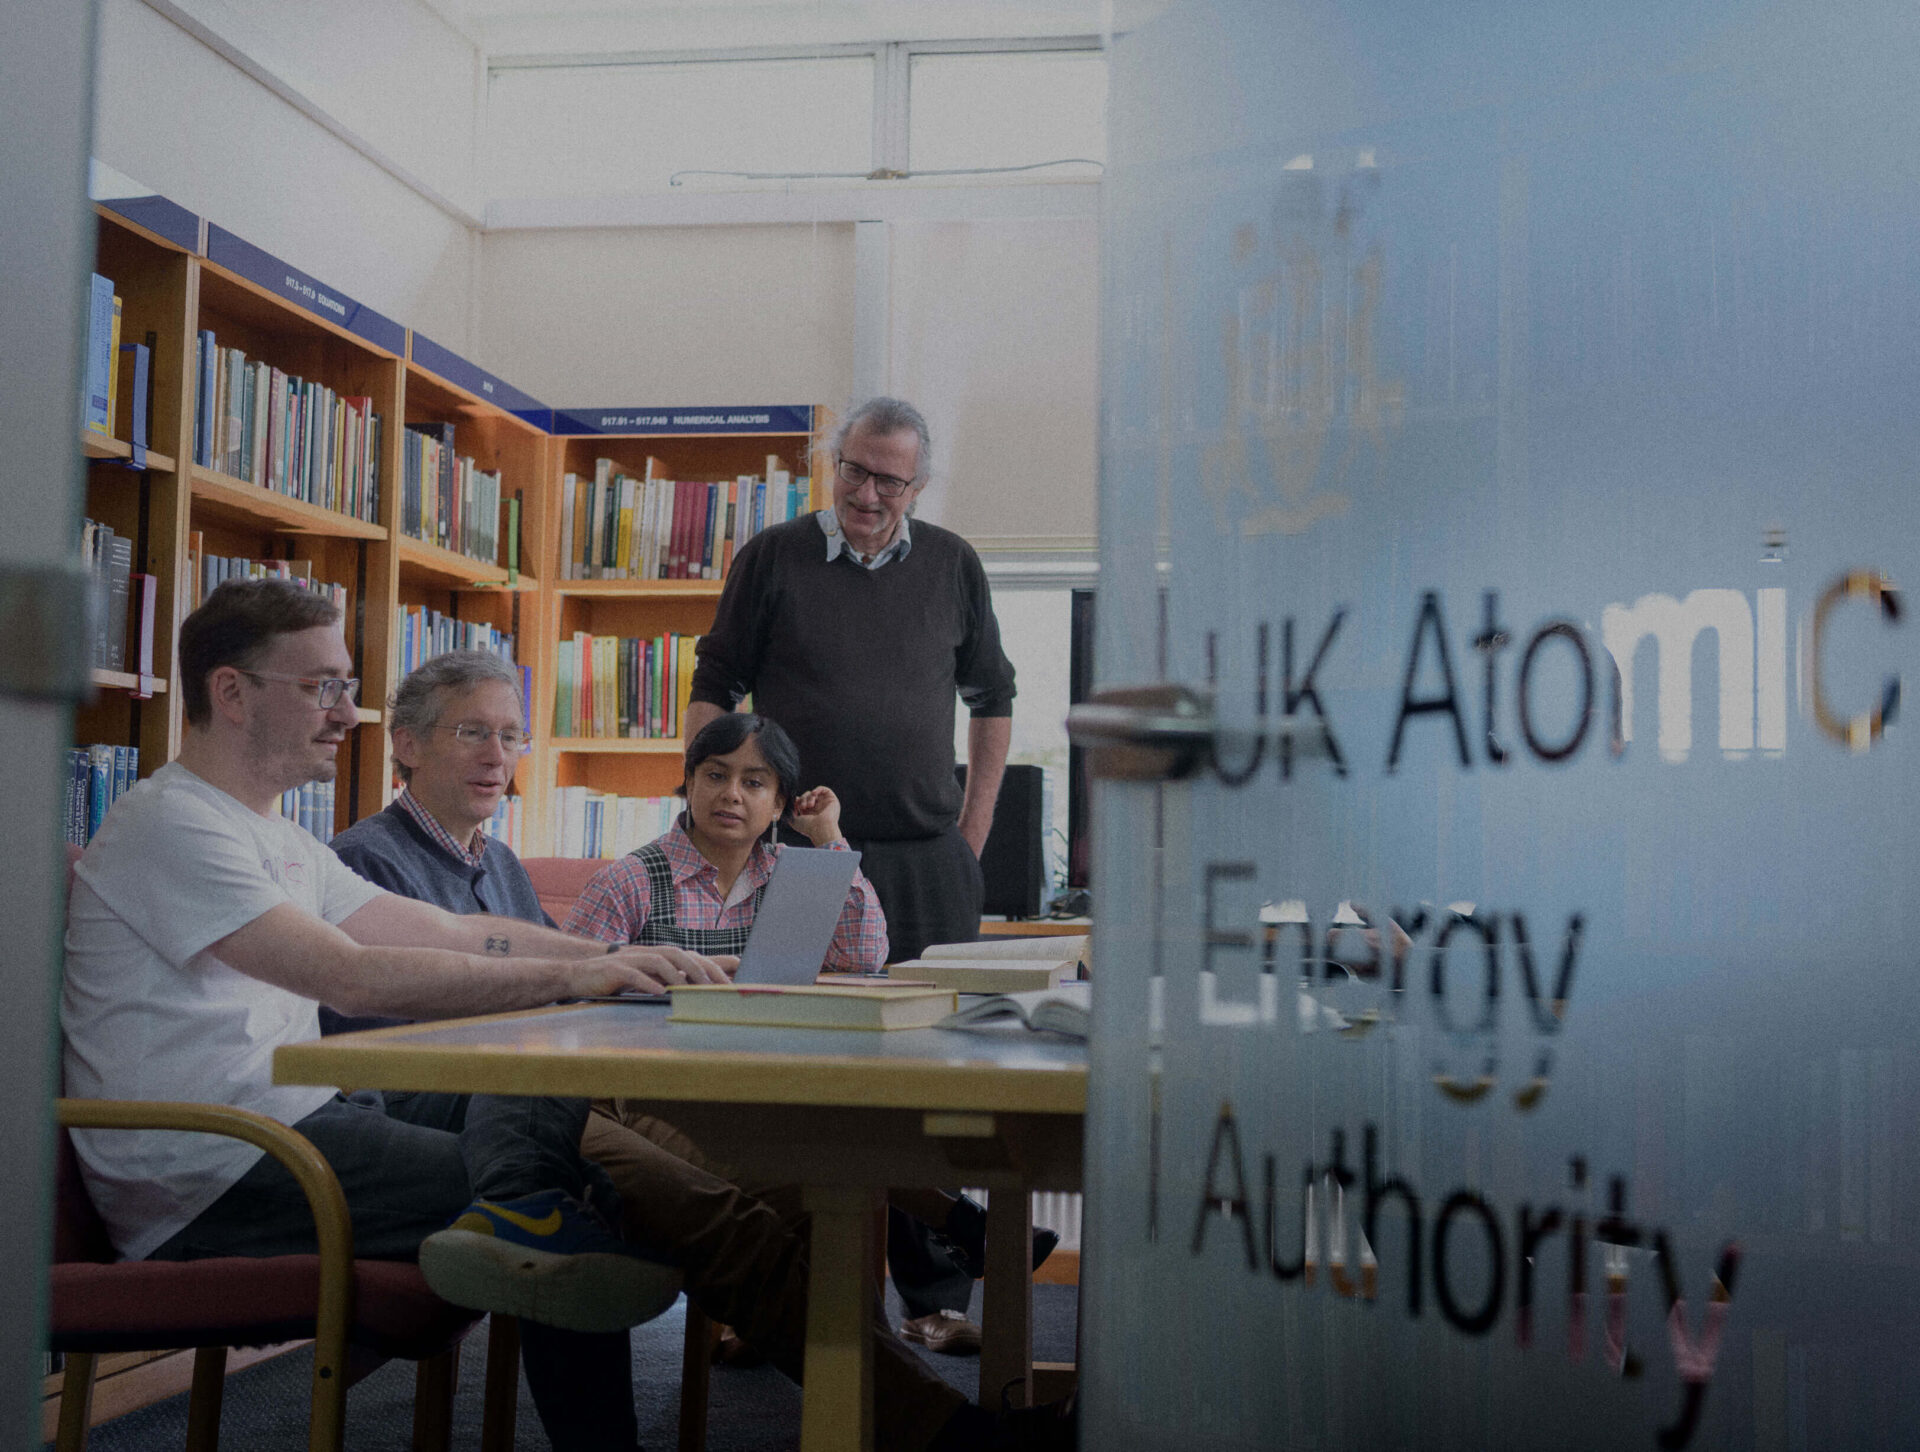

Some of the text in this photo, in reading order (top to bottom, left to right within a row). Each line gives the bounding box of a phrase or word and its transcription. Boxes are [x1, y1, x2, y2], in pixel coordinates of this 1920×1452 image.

[673, 414, 726, 425] NUMERICAL
[727, 413, 770, 424] ANALYSIS
[1208, 531, 1905, 788] UK Atomic
[1200, 862, 1584, 1110] Energy
[1192, 1100, 1742, 1450] Authority
